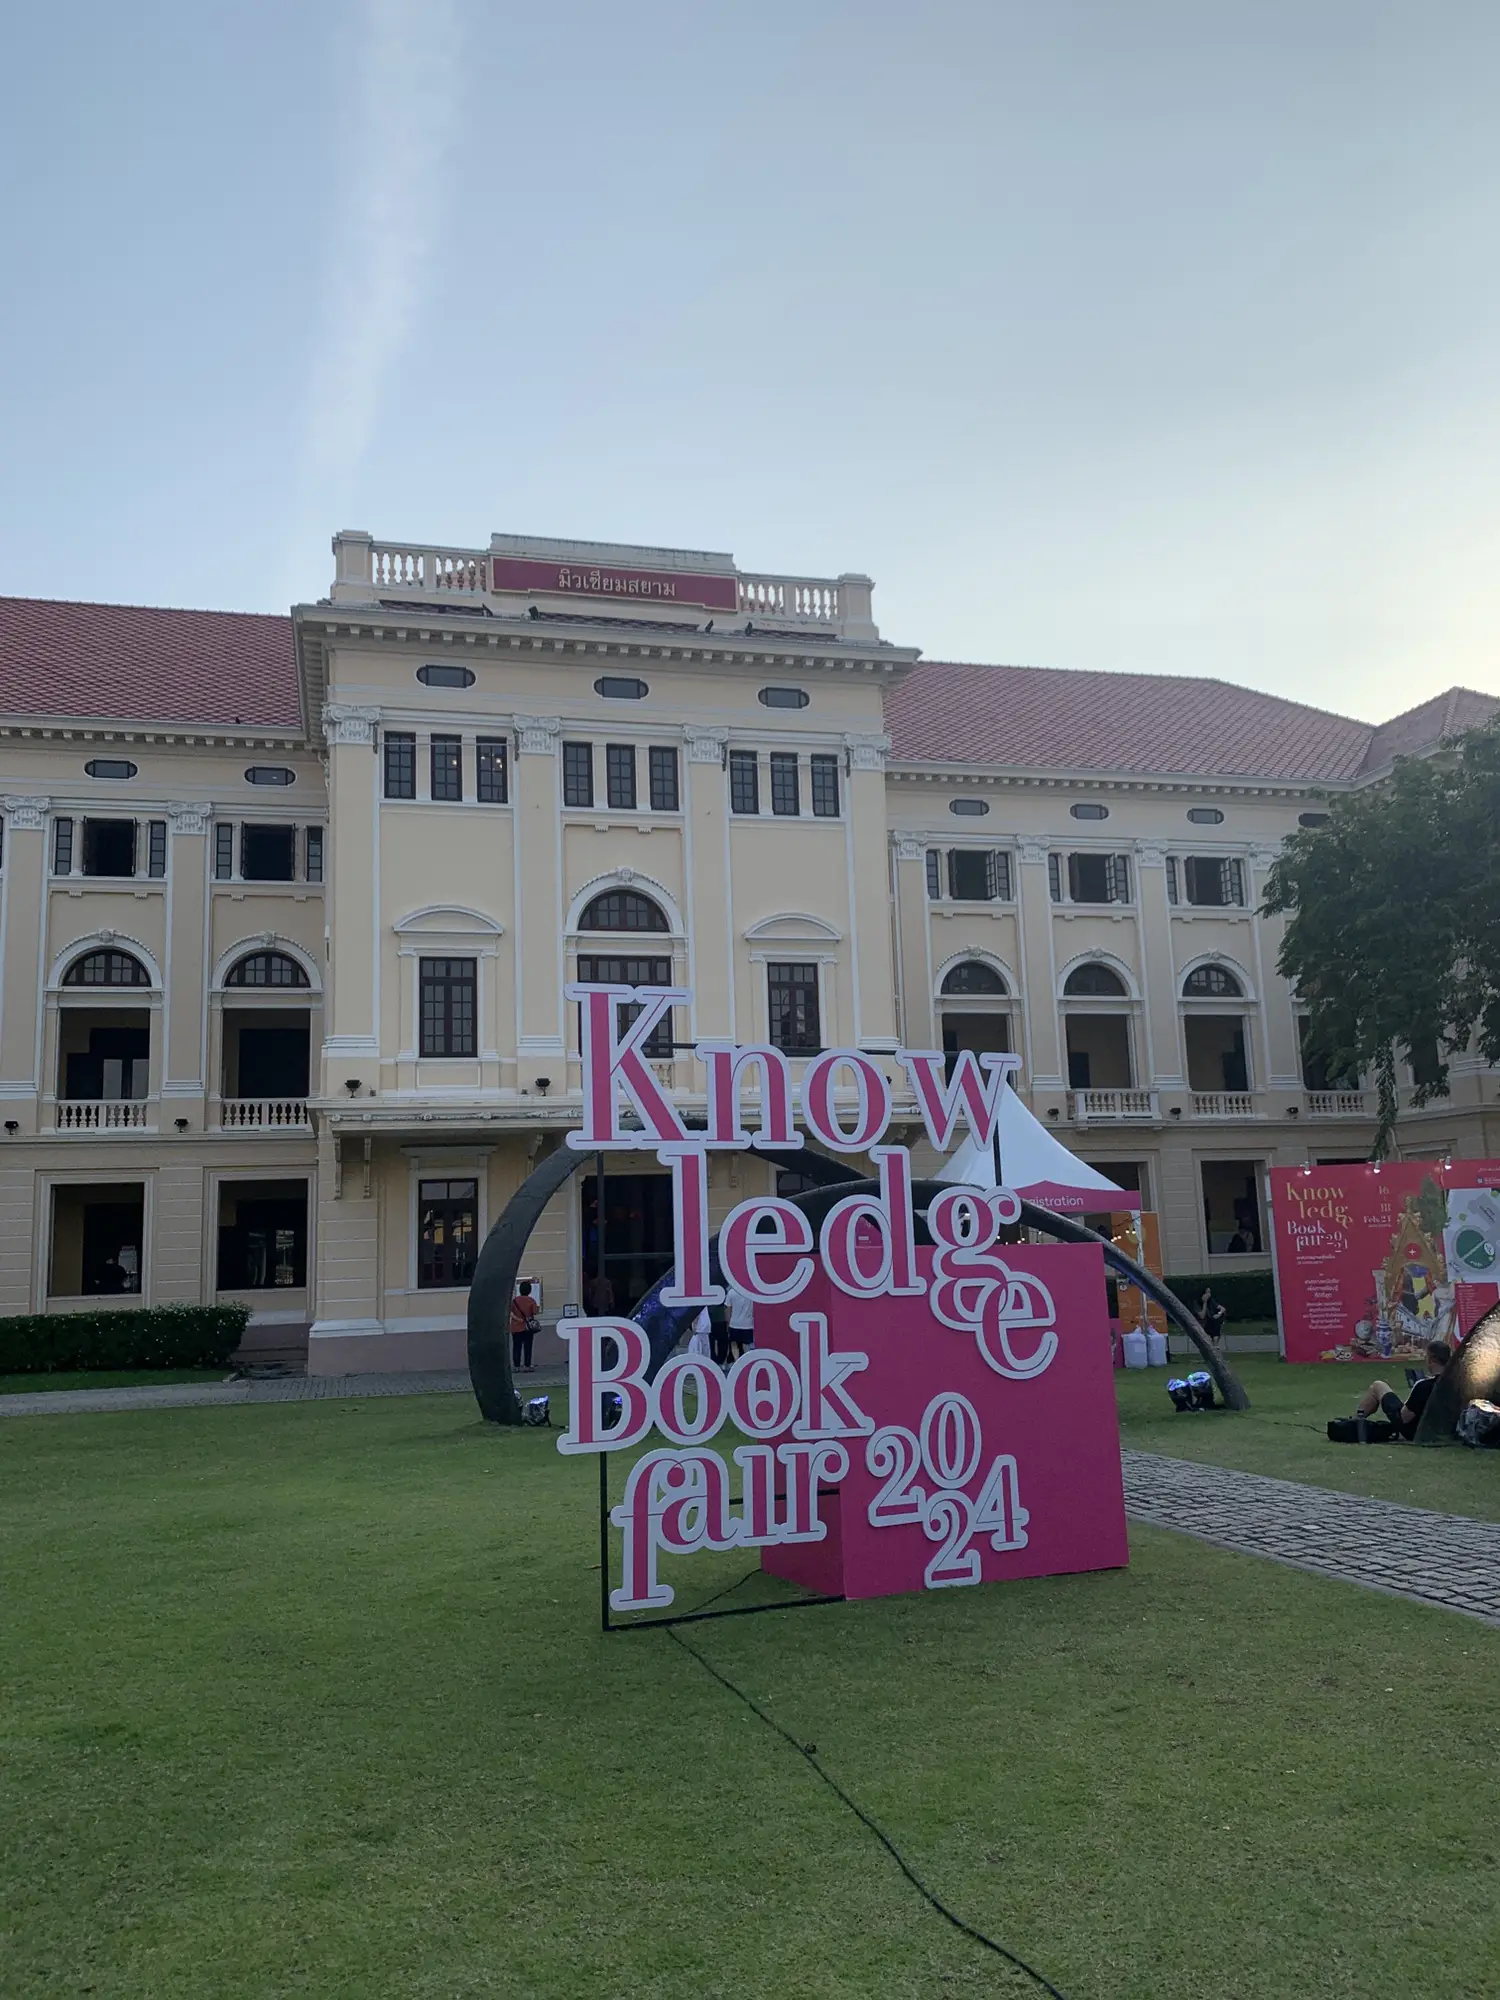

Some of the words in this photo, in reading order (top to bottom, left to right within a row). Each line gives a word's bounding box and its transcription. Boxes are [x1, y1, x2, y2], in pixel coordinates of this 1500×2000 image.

[558, 568, 676, 596] มิวเซียมสยาม
[565, 983, 1022, 1152] Know
[1286, 1182, 1345, 1201] Know
[1287, 1220, 1326, 1235] Book
[657, 1146, 1059, 1380] ledge
[1296, 1235, 1324, 1252] fair
[556, 1312, 875, 1454] Book
[610, 1441, 850, 1611] fair
